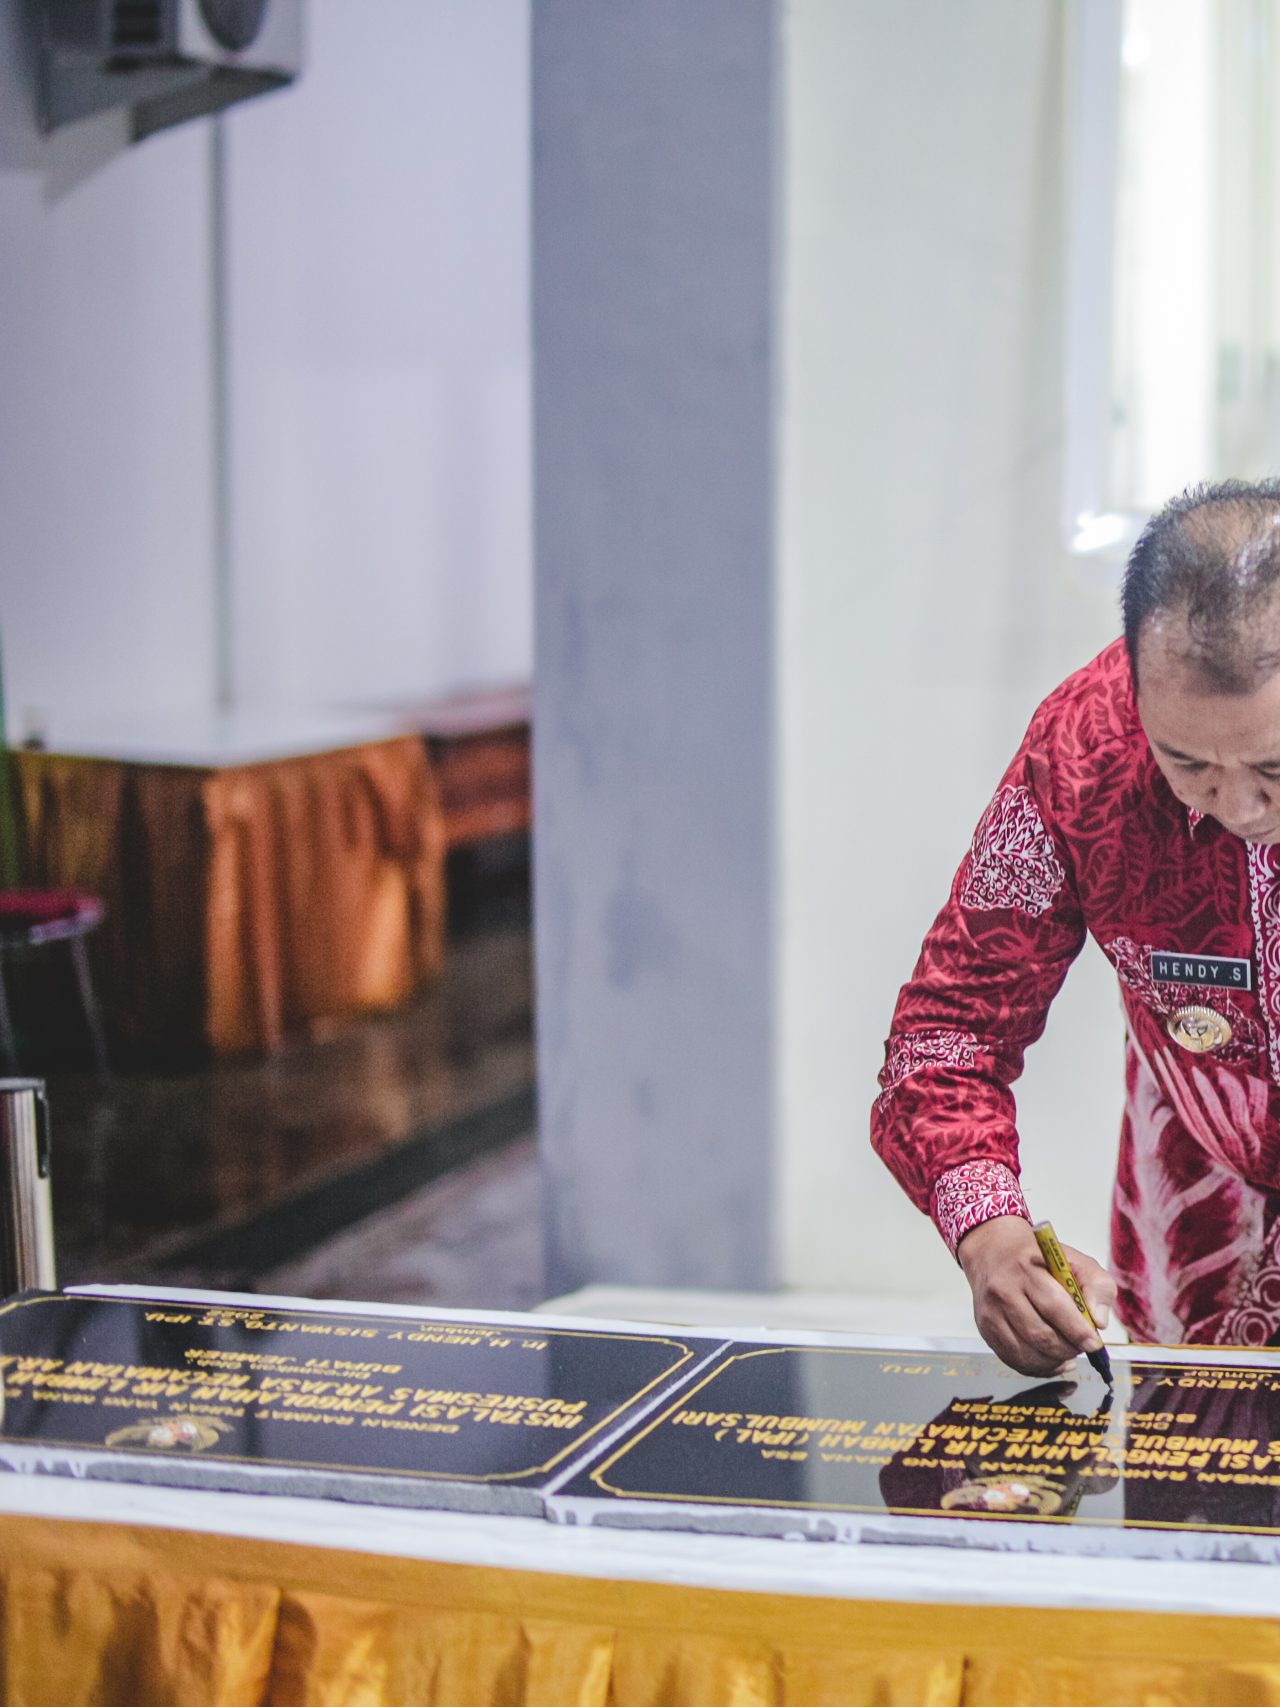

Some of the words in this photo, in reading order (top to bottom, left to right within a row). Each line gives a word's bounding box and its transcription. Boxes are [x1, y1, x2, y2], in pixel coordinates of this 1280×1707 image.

[1159, 962, 1219, 980] HENDY
[388, 1331, 481, 1345] HENDY
[184, 1349, 296, 1365] JEMBER
[305, 1359, 402, 1374] BUPATI
[260, 1377, 383, 1398] ARJASA
[1156, 1377, 1258, 1390] HENDY
[191, 1386, 404, 1416] PENGOLAHAN
[389, 1388, 587, 1414] PUSKESMAS
[951, 1403, 1070, 1417] JEMBER
[409, 1403, 584, 1429] INSTALASI
[672, 1410, 866, 1434] MUMBULSARI
[1034, 1417, 1169, 1431] Diremikan
[874, 1422, 1048, 1443] KECAMATAN
[819, 1434, 935, 1453] LIMBAH
[943, 1441, 998, 1456] AIR
[1003, 1443, 1210, 1468] PENGOLAHAN
[979, 1462, 1065, 1475] TUHAN
